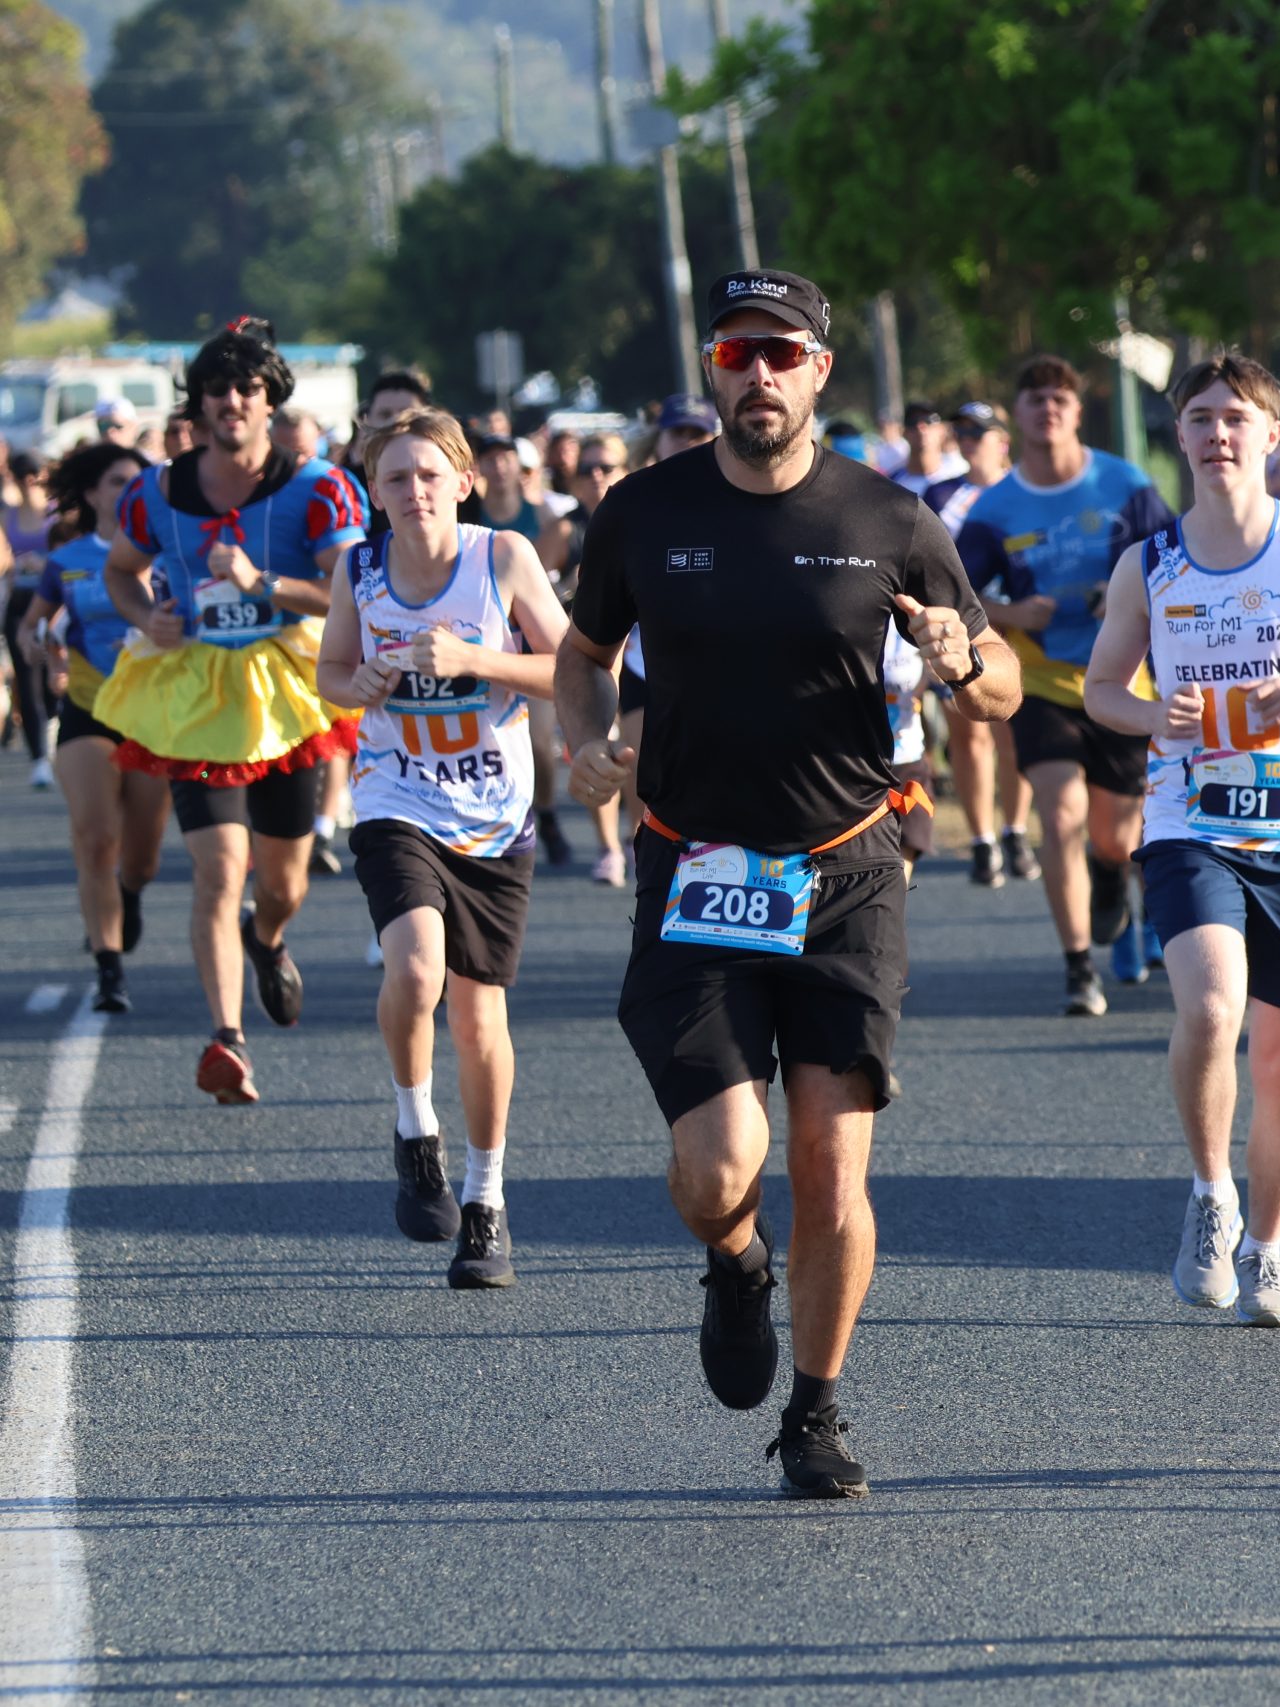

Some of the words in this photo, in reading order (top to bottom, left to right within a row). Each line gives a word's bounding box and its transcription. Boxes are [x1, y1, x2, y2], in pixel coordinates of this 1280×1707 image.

[727, 280, 746, 294] Be
[751, 277, 788, 295] Kind
[1154, 530, 1168, 549] Be
[359, 547, 373, 567] Be
[818, 556, 845, 566] The
[848, 556, 876, 568] Run
[217, 603, 258, 628] 539
[1166, 620, 1191, 635] Run
[1195, 620, 1216, 634] for
[1221, 616, 1242, 632] MI
[1206, 633, 1236, 649] Life
[408, 672, 454, 698] 192
[1226, 786, 1269, 818] 191
[760, 858, 785, 879] 10
[752, 876, 787, 889] YEARS
[700, 885, 770, 926] 208
